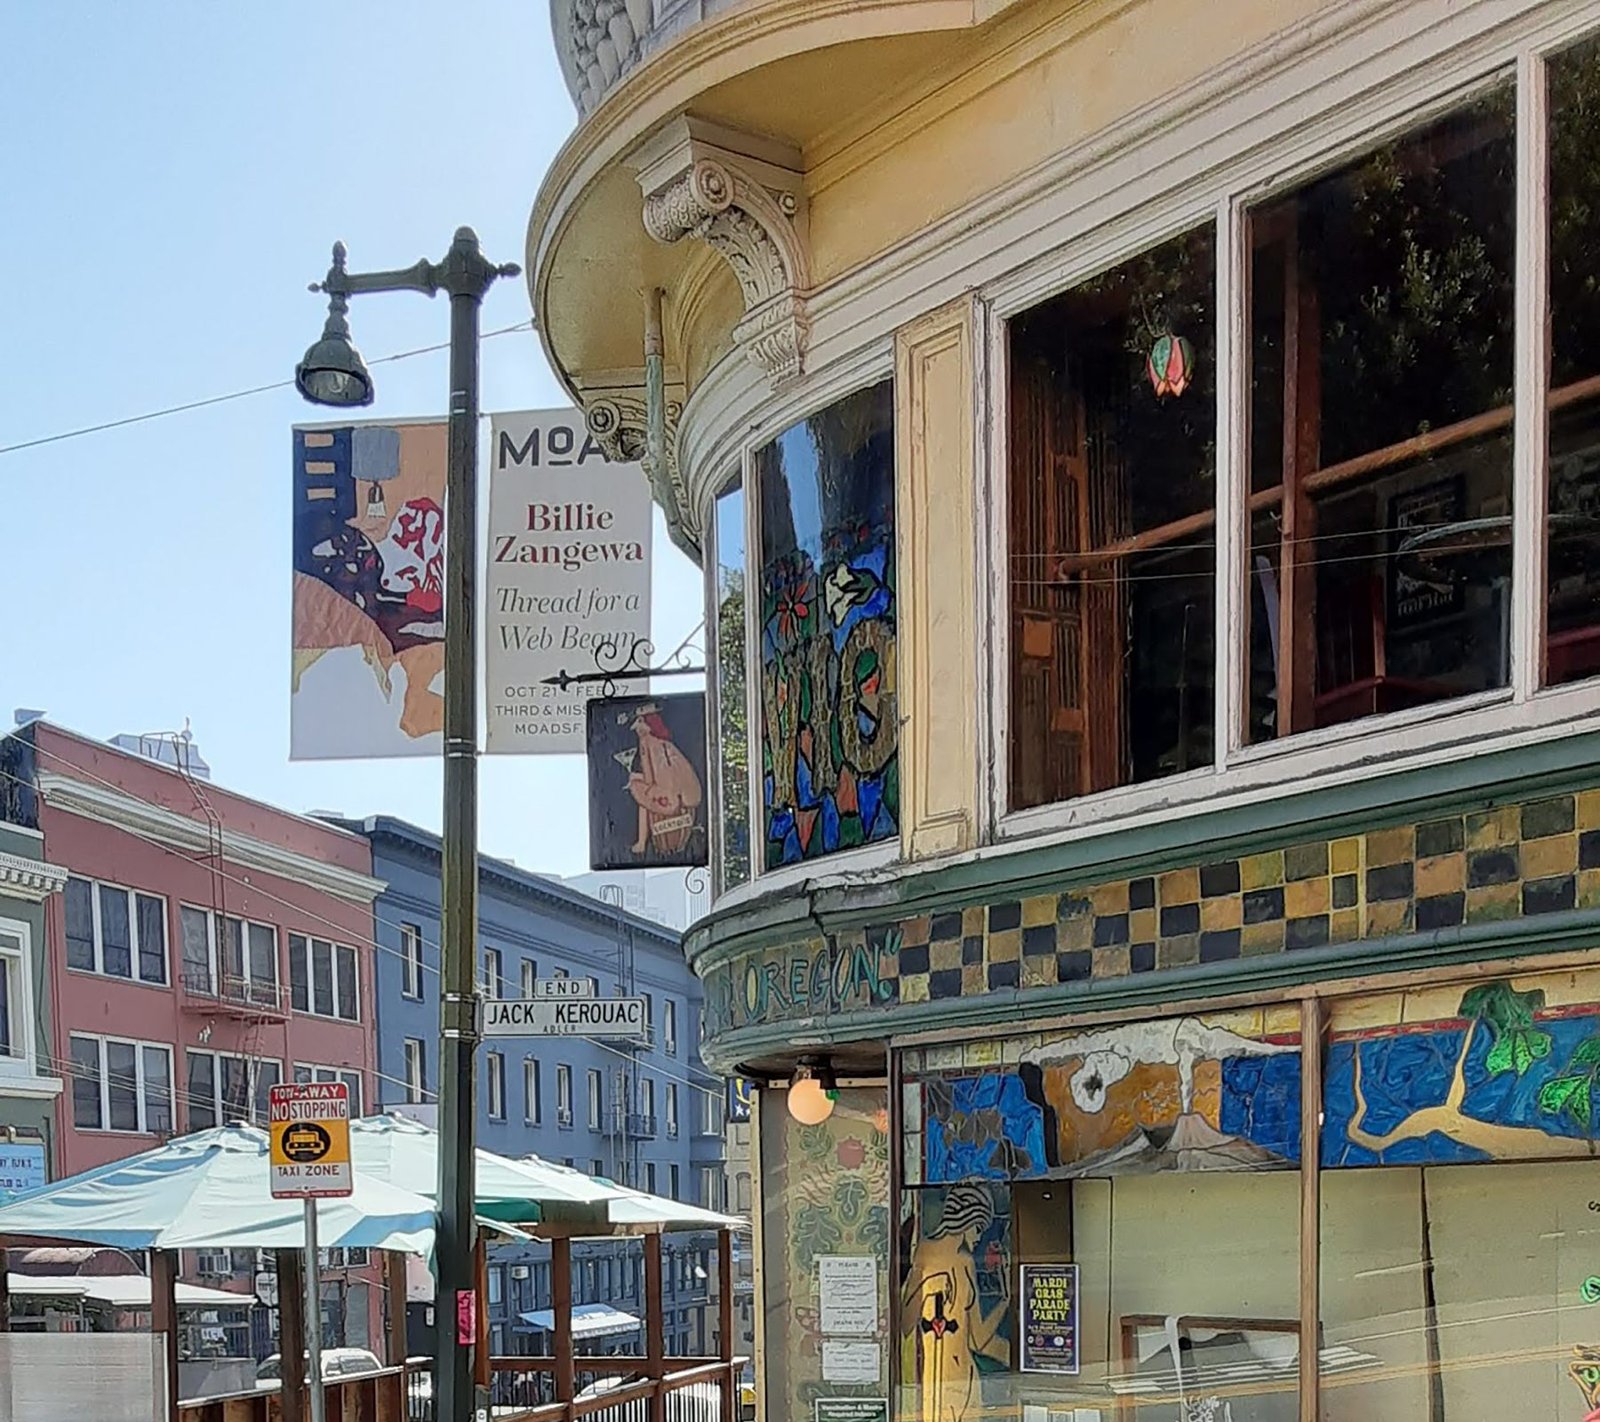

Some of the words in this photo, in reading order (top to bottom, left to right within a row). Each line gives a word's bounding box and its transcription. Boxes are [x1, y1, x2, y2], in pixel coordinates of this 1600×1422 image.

[527, 503, 614, 532] Billie
[494, 535, 644, 572] Zangewa
[496, 588, 582, 614] Thread
[582, 588, 621, 619] for
[625, 594, 641, 611] a
[500, 625, 553, 651] Web
[560, 625, 636, 655] Begun
[504, 686, 537, 698] OCT
[541, 686, 557, 698] 21
[495, 705, 540, 717] THIRD
[543, 705, 552, 716] &
[545, 982, 580, 995] END
[488, 1004, 534, 1025] JACK
[555, 1003, 639, 1023] KEROUAC
[543, 1025, 577, 1034] ADLER
[273, 1086, 340, 1100] TOW-AWAY
[272, 1102, 289, 1121] NO
[291, 1101, 346, 1119] STOPPING
[277, 1166, 300, 1177] TAXI
[305, 1165, 340, 1177] ZONE
[1032, 1277, 1068, 1289] MARDI
[1035, 1288, 1064, 1299] GRAS
[1029, 1299, 1071, 1311] PARADE
[1032, 1310, 1068, 1321] PARTY
